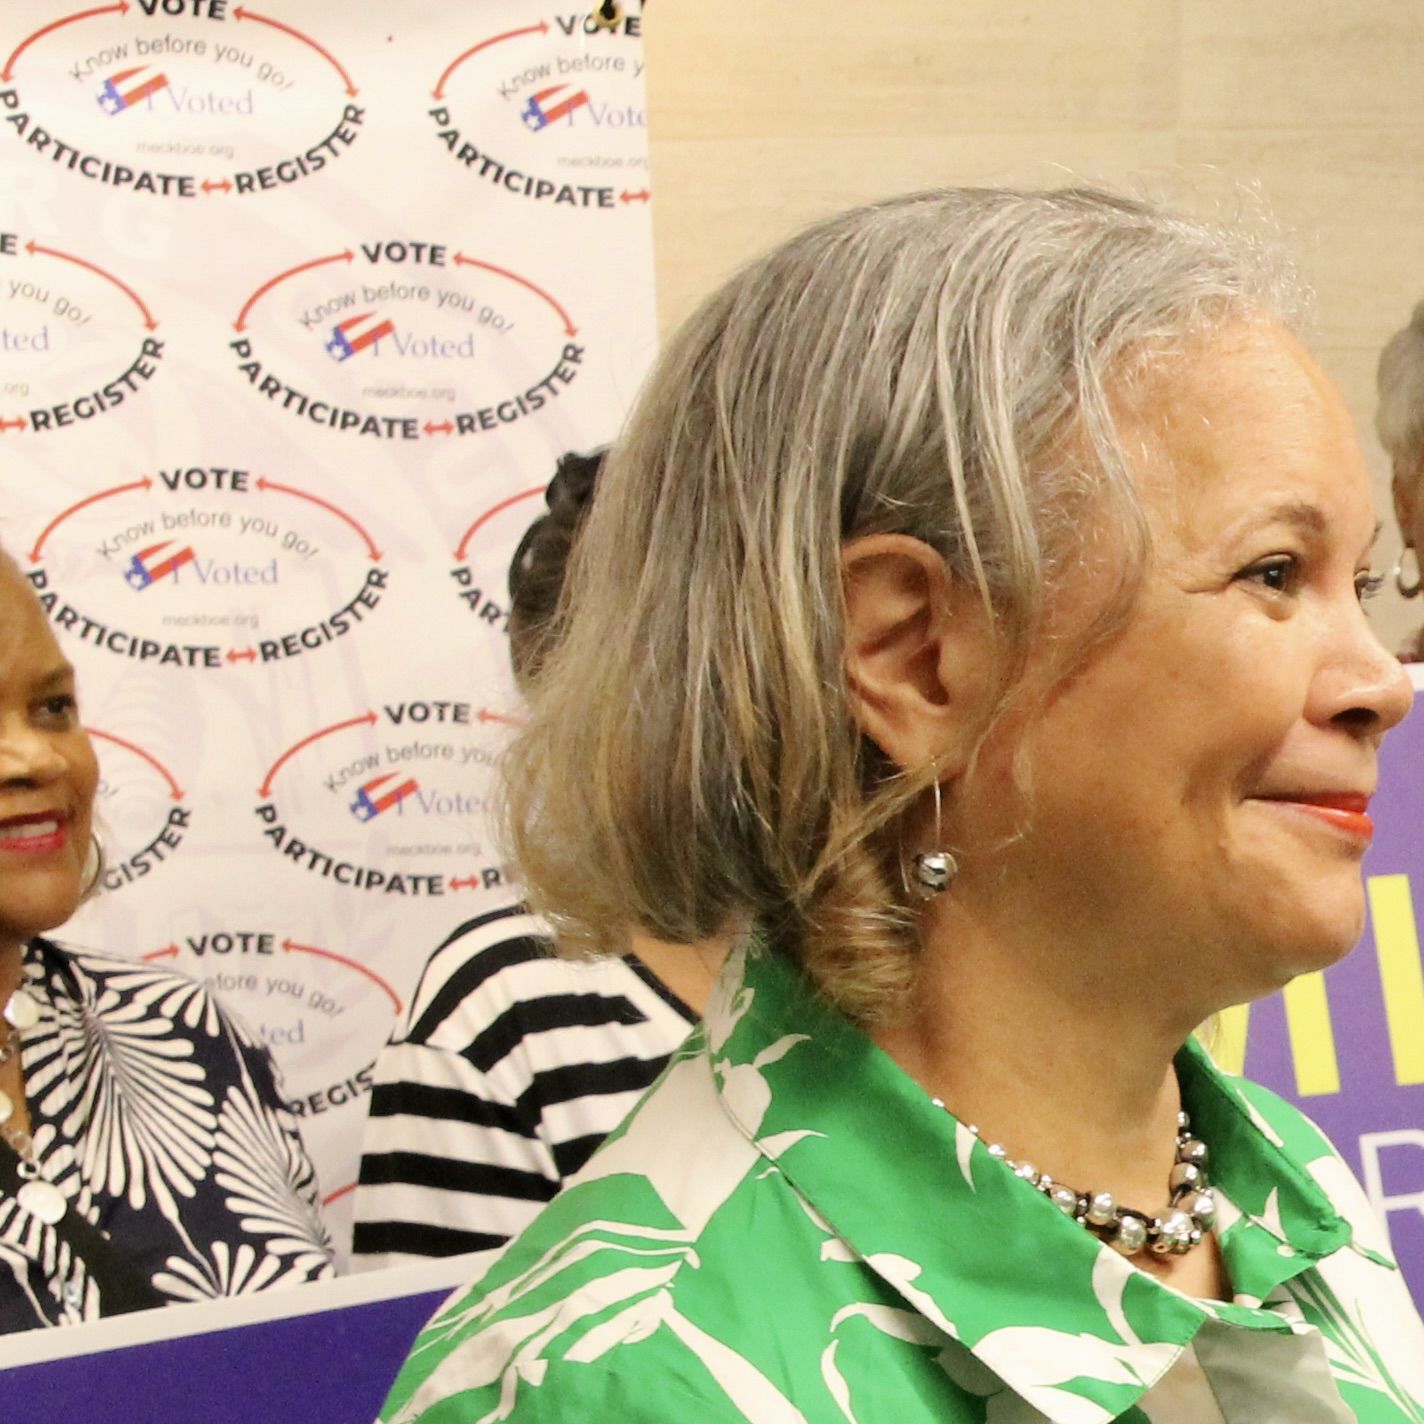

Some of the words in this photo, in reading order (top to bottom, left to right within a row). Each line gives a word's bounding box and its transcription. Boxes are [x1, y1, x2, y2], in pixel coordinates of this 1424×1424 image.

[139, 0, 228, 21] VOTE
[555, 15, 642, 37] VOE
[69, 43, 129, 83] Know
[135, 33, 207, 57] before
[214, 42, 254, 68] you
[497, 63, 551, 102] Know
[556, 53, 625, 74] before
[165, 88, 254, 115] Voted
[0, 88, 197, 198] PARTICIPATE
[234, 102, 366, 196] REGISTER
[428, 106, 615, 208] PARTICIPATE
[361, 241, 448, 267] VOTE
[8, 279, 51, 303] you
[297, 290, 357, 330] Know
[362, 281, 431, 303] before
[436, 287, 475, 314] you
[392, 333, 475, 360] Voted
[30, 338, 165, 432] REGISTER
[229, 338, 419, 440] PARTICIPATE
[456, 342, 586, 437] REGISTER
[159, 467, 250, 492] VOTE
[96, 518, 156, 560] Know
[161, 507, 232, 531] before
[239, 514, 278, 540] you
[192, 559, 278, 586] Voted
[25, 568, 222, 670] PARTICIPATE
[258, 567, 389, 663] REGISTER
[384, 702, 470, 725] VOTE
[323, 753, 380, 793] Know
[386, 740, 455, 763] before
[255, 804, 445, 896] PARTICIPATE
[186, 933, 275, 956] VOTE
[266, 976, 304, 998] you
